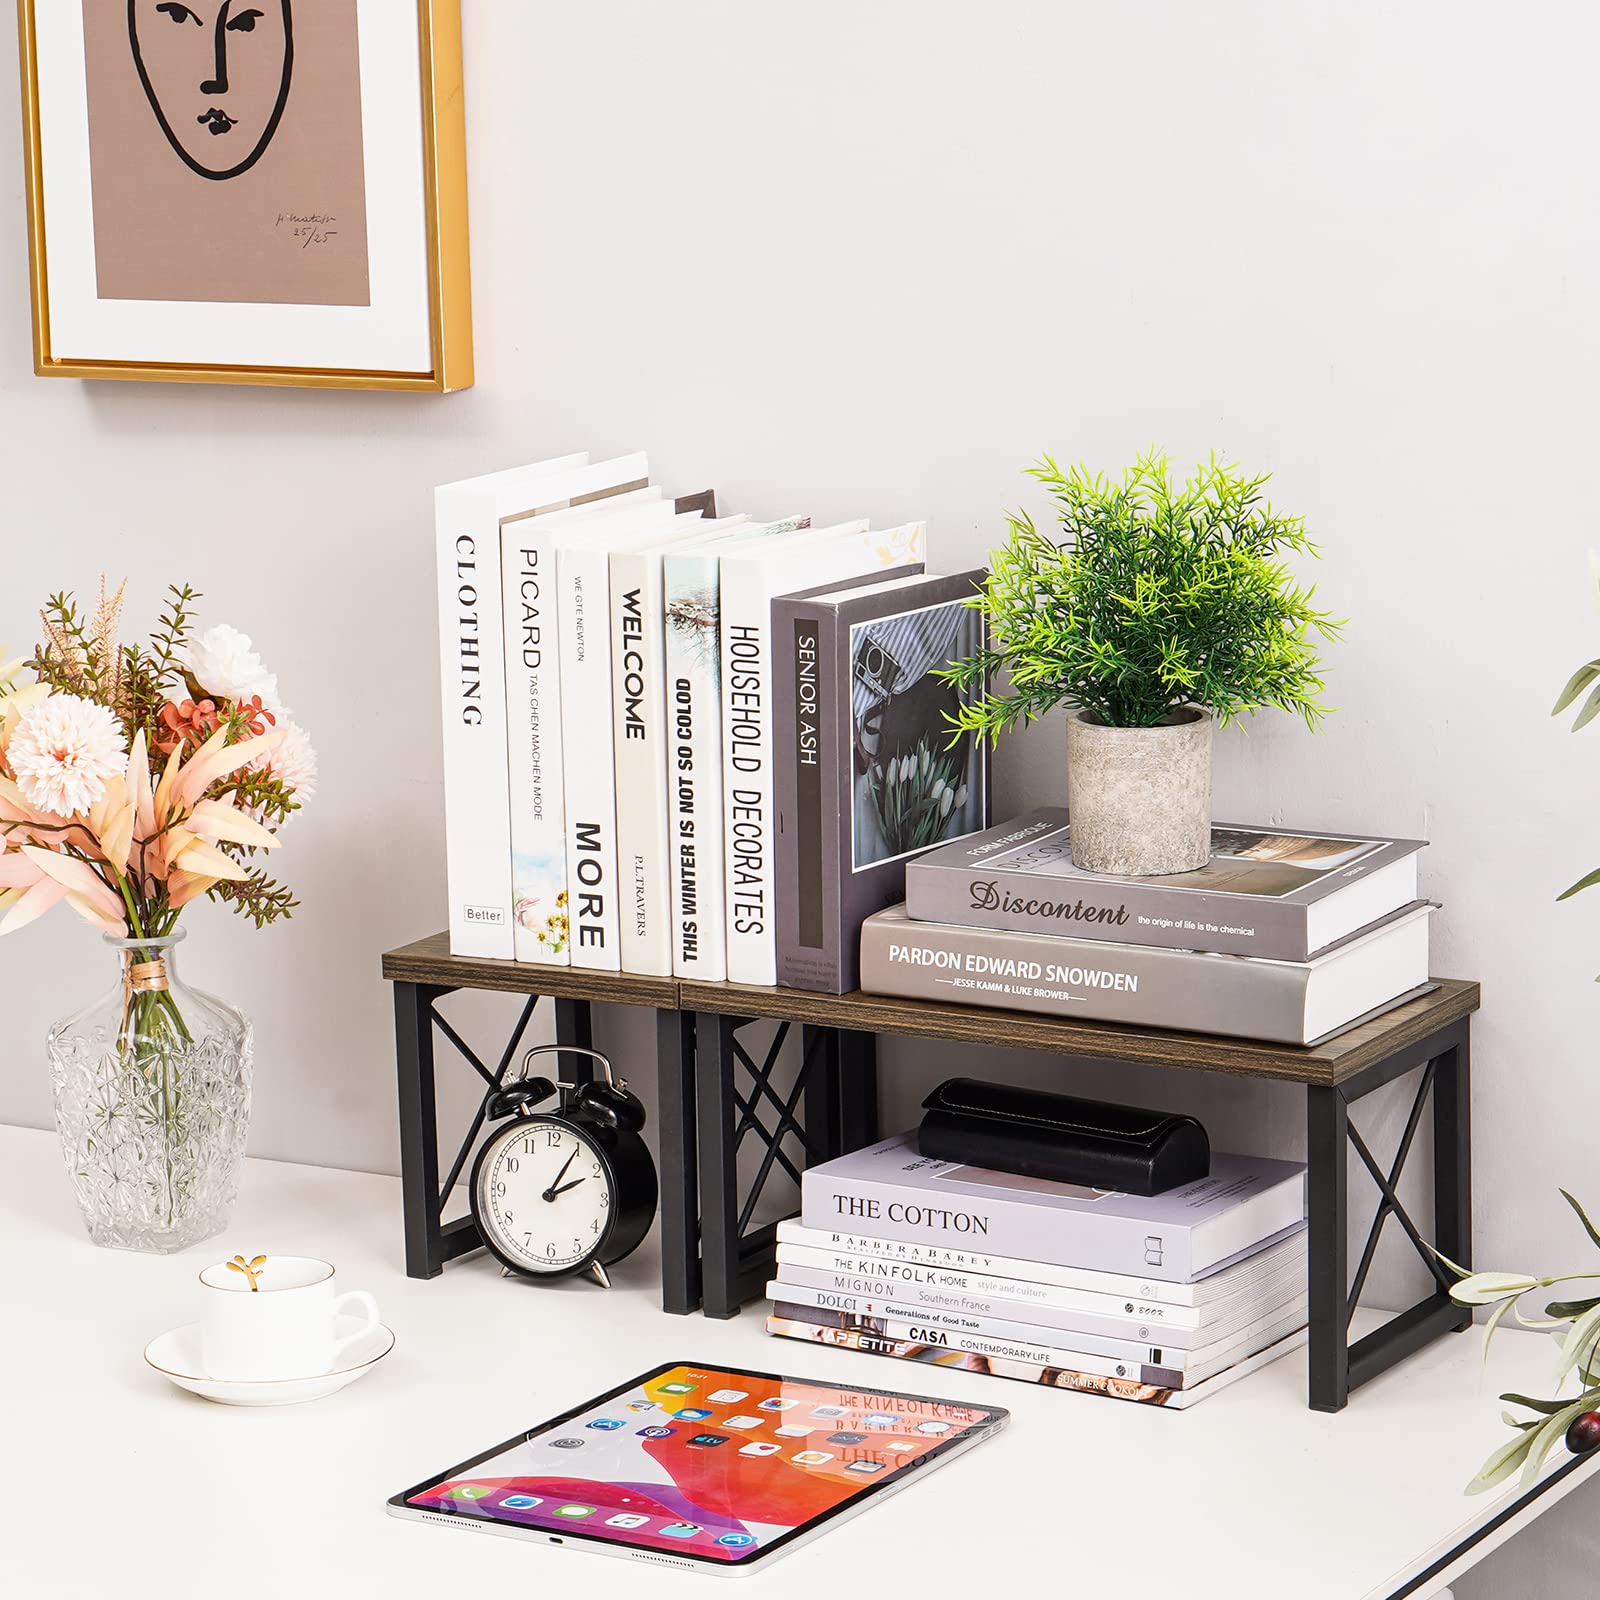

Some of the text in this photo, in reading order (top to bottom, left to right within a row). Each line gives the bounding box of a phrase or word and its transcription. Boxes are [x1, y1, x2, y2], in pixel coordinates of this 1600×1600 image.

[574, 576, 582, 592] WE
[455, 534, 482, 728] CLOTHING
[576, 618, 585, 661] NEWTON
[622, 588, 646, 740] WELCOME
[519, 549, 542, 821] PICARD TAS CHEN MACHEN MODE
[798, 635, 817, 765] SENIOR ASH
[730, 625, 764, 935] HOUSEHOLD DECORATES
[675, 678, 698, 962] THIS WINTER IS NOT SO COLOD
[575, 822, 605, 948] MORE
[466, 908, 502, 922] Better
[969, 880, 1255, 937] Discontent the origin of life is the chemical
[888, 944, 1139, 993] PARDON EDWARD SNOWDEN
[952, 977, 976, 988] JESSE
[976, 980, 1003, 992] KAMM
[1011, 985, 1033, 997] LUKE
[1033, 988, 1070, 1001] BROWER
[523, 1138, 535, 1154] 11
[546, 1131, 561, 1148] 12
[575, 1141, 582, 1157] 1
[506, 1157, 520, 1174] 10
[592, 1162, 601, 1179] 2
[496, 1182, 506, 1198] 9
[600, 1191, 609, 1208] 3
[504, 1210, 514, 1226] 8
[589, 1218, 600, 1234] 4
[833, 1194, 989, 1235] THE COTTON
[523, 1231, 533, 1247] 7
[546, 1242, 556, 1258] 6
[572, 1238, 582, 1253] 5
[834, 1258, 1048, 1298] THE KINFOLK HOME style and culture
[834, 1276, 991, 1312] MIGNON Southern France
[816, 1292, 980, 1329] DOLCI Generations of Good Taste
[909, 1326, 1051, 1363] CASA CONTEMPORARY LIFE
[1057, 1375, 1099, 1390] SUMMER
